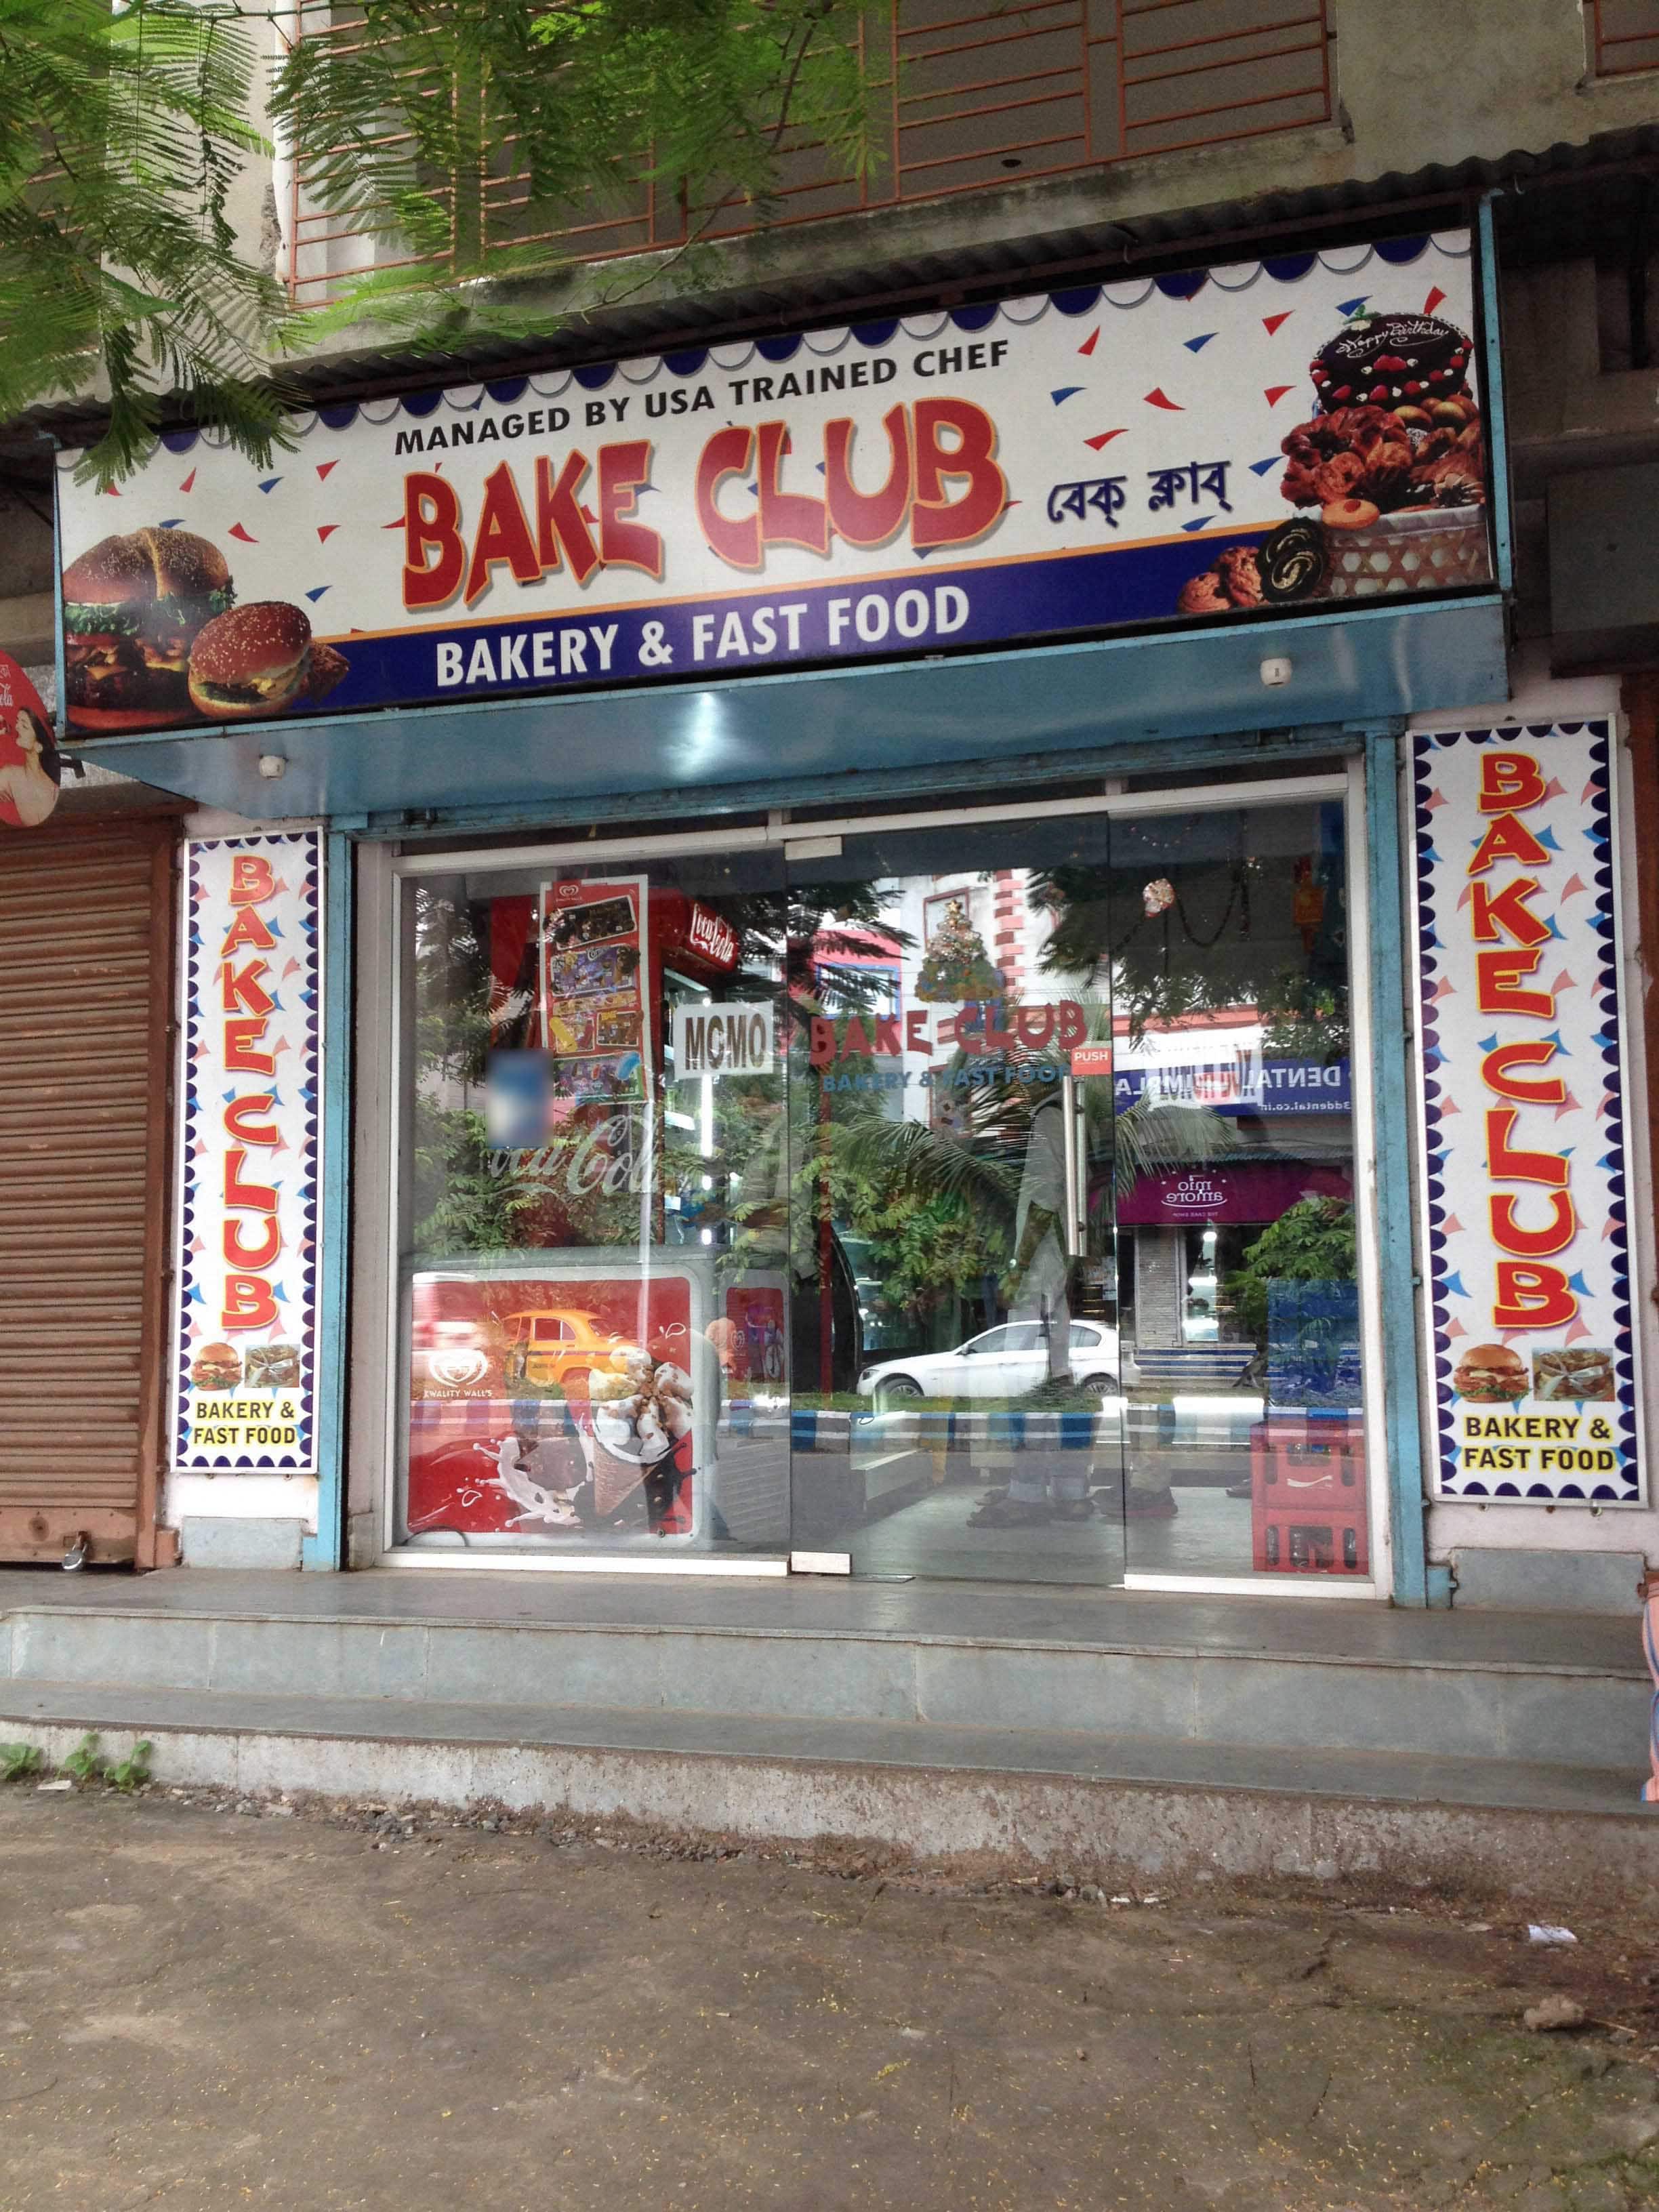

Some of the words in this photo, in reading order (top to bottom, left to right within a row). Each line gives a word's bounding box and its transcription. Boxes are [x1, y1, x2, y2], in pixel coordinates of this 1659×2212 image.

[395, 407, 571, 455] MANAGED
[586, 396, 630, 427] BY
[645, 386, 715, 418] USA
[729, 358, 897, 406] TRAINED
[913, 340, 1008, 377] CHEF
[402, 441, 662, 608] BAKE
[695, 396, 1008, 569] CLUB
[436, 624, 619, 687] BAKERY
[638, 620, 674, 667] &
[693, 603, 808, 661] FAST
[828, 586, 970, 647] FOOD
[1469, 751, 1556, 1019] BAKE
[220, 855, 277, 1076] BAKE
[809, 1009, 933, 1066] BAKE
[954, 1000, 1086, 1055] CLUB
[1074, 1051, 1108, 1062] PUSH
[823, 1071, 912, 1092] BAKERY
[919, 1070, 933, 1088] &
[943, 1066, 1004, 1088] FAST
[220, 1094, 281, 1330] CLUB
[1481, 1040, 1578, 1330] CLUB
[197, 1402, 274, 1418] BAKERY
[281, 1401, 295, 1418] &
[424, 1390, 461, 1398] KWALITY
[464, 1389, 493, 1397] WALL'S
[194, 1427, 239, 1444] FAST
[245, 1427, 295, 1444] FOOD
[1464, 1448, 1531, 1469] FAST
[1541, 1449, 1614, 1470] FOOD
[1466, 1417, 1579, 1438] BAKERY
[1589, 1418, 1610, 1439] &
